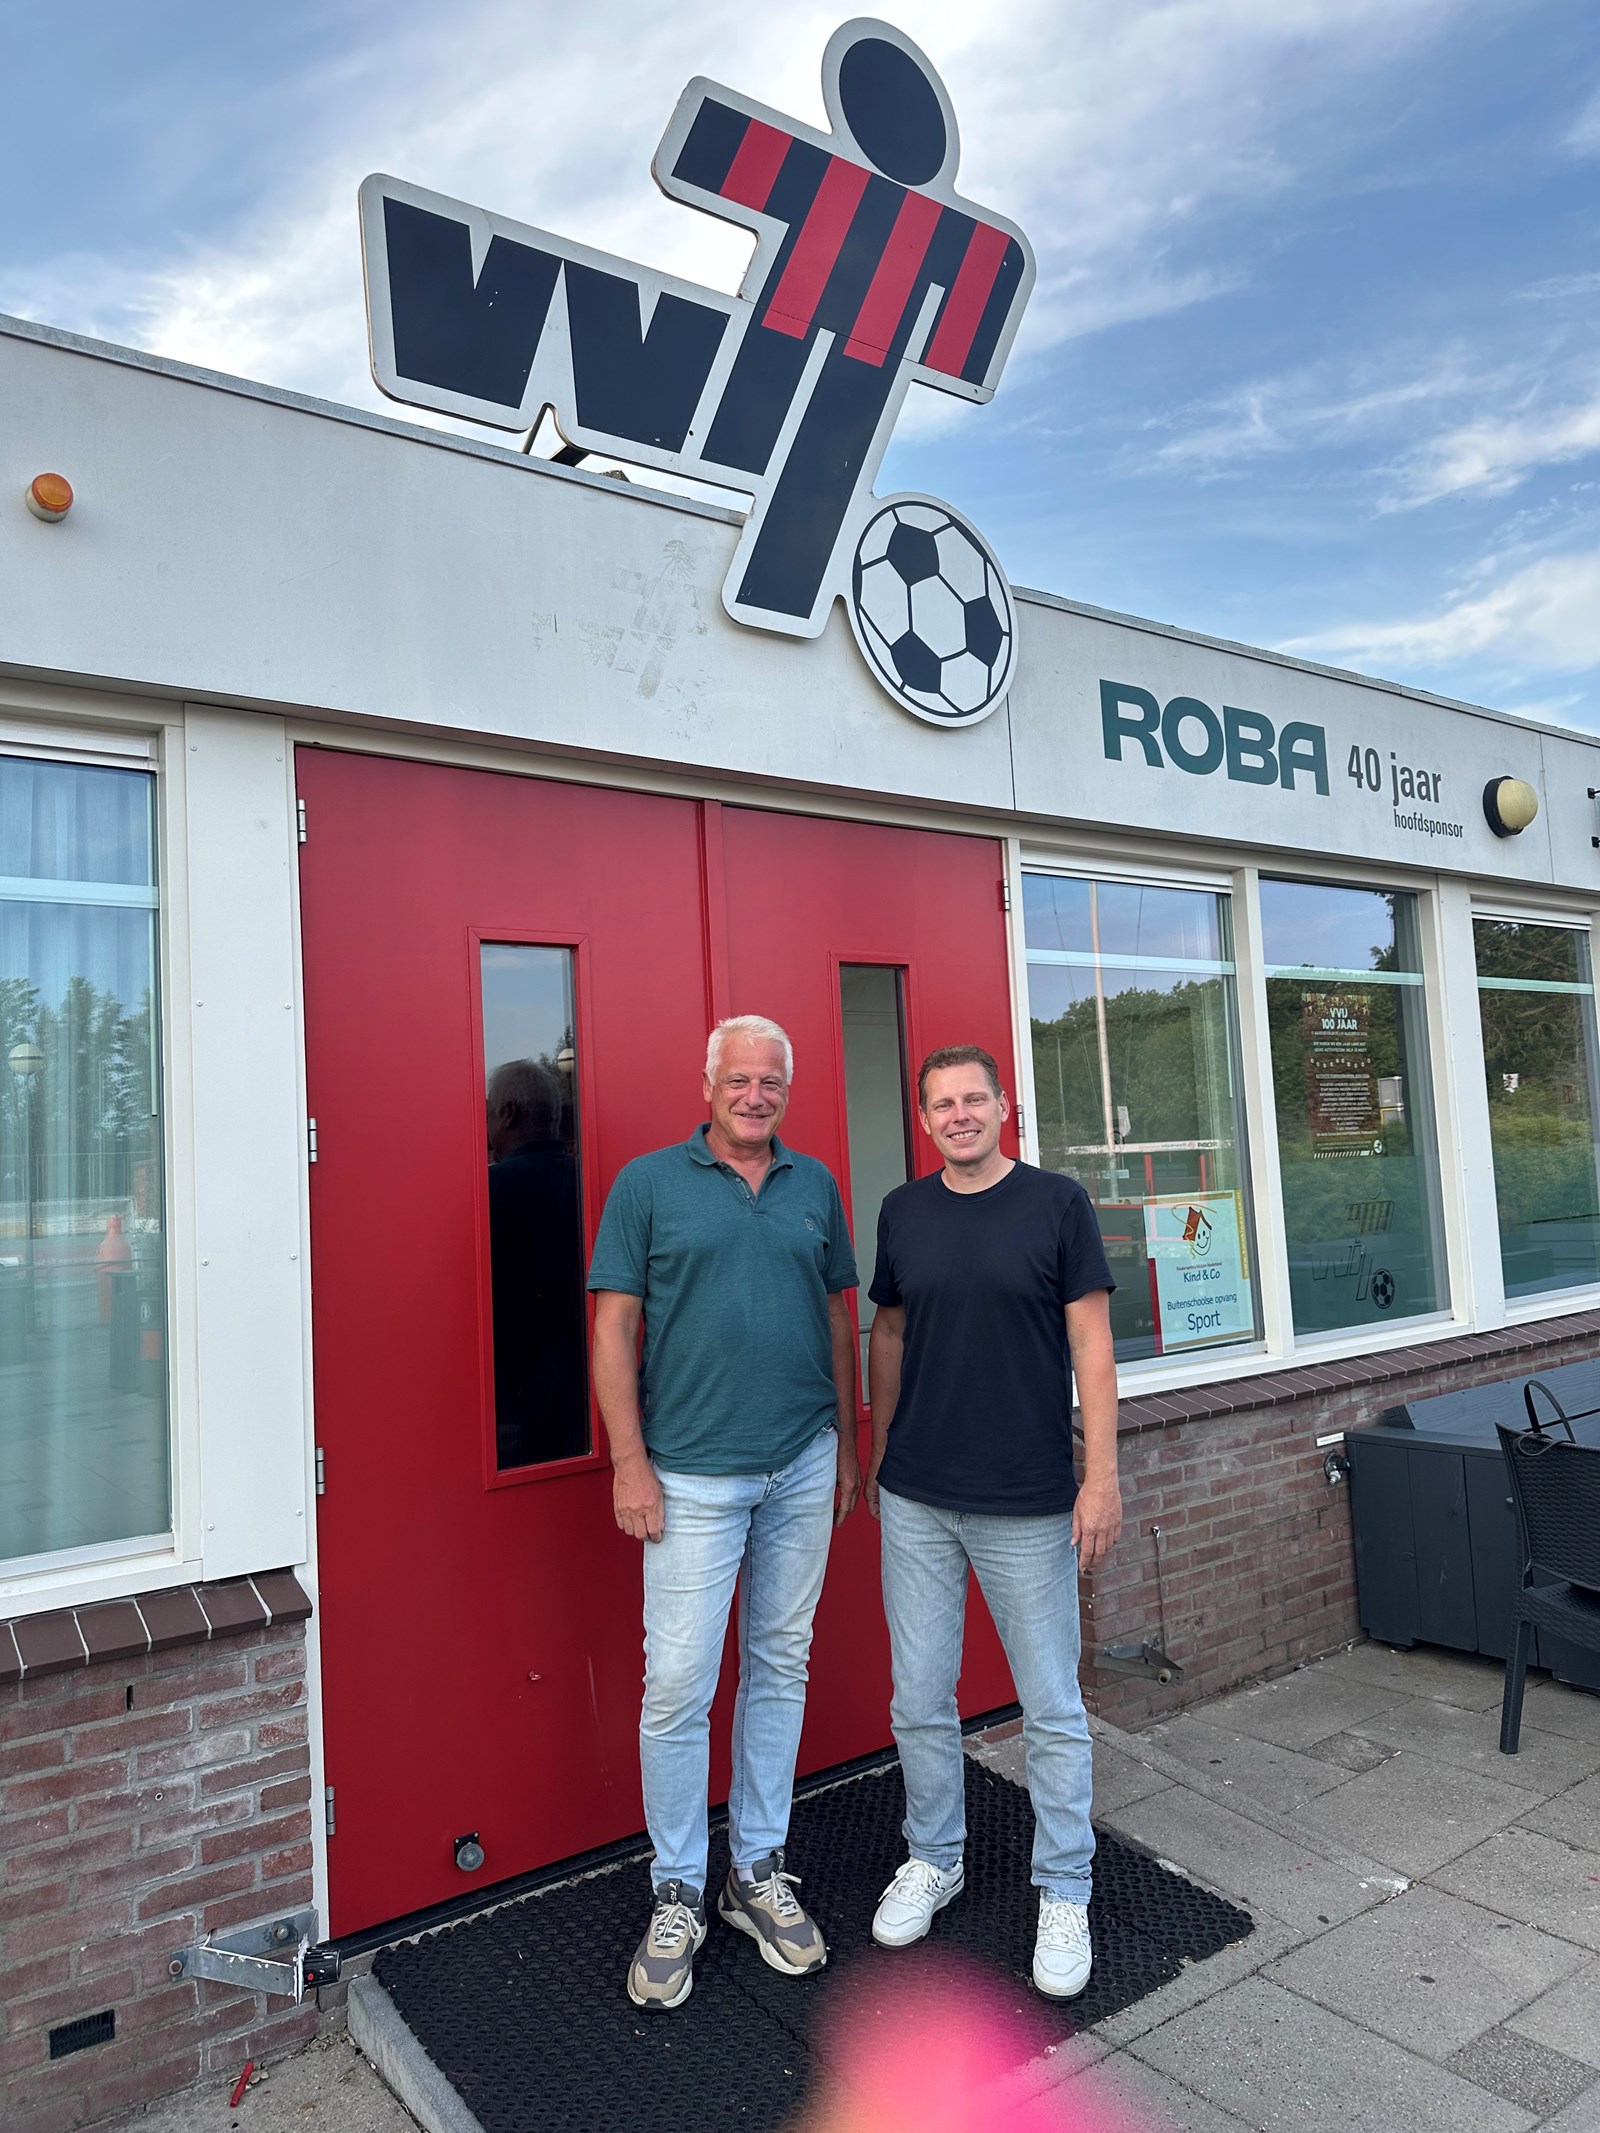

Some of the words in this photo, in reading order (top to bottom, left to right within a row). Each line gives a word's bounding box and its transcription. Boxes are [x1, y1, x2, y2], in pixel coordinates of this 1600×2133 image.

[1099, 679, 1330, 796] ROBA
[1347, 744, 1381, 792] 40
[1390, 752, 1441, 806] jaar
[1393, 808, 1464, 838] hoofdsponsor
[1329, 1007, 1348, 1018] VVIJ
[1321, 1019, 1335, 1030] 100
[1336, 1019, 1358, 1030] JAAR
[1183, 1270, 1201, 1283] Kind
[1202, 1269, 1209, 1281] &
[1210, 1268, 1221, 1279] Co
[1167, 1297, 1214, 1311] Buitenschoolse
[1215, 1293, 1238, 1306] opvang
[1188, 1310, 1222, 1333] Sport
